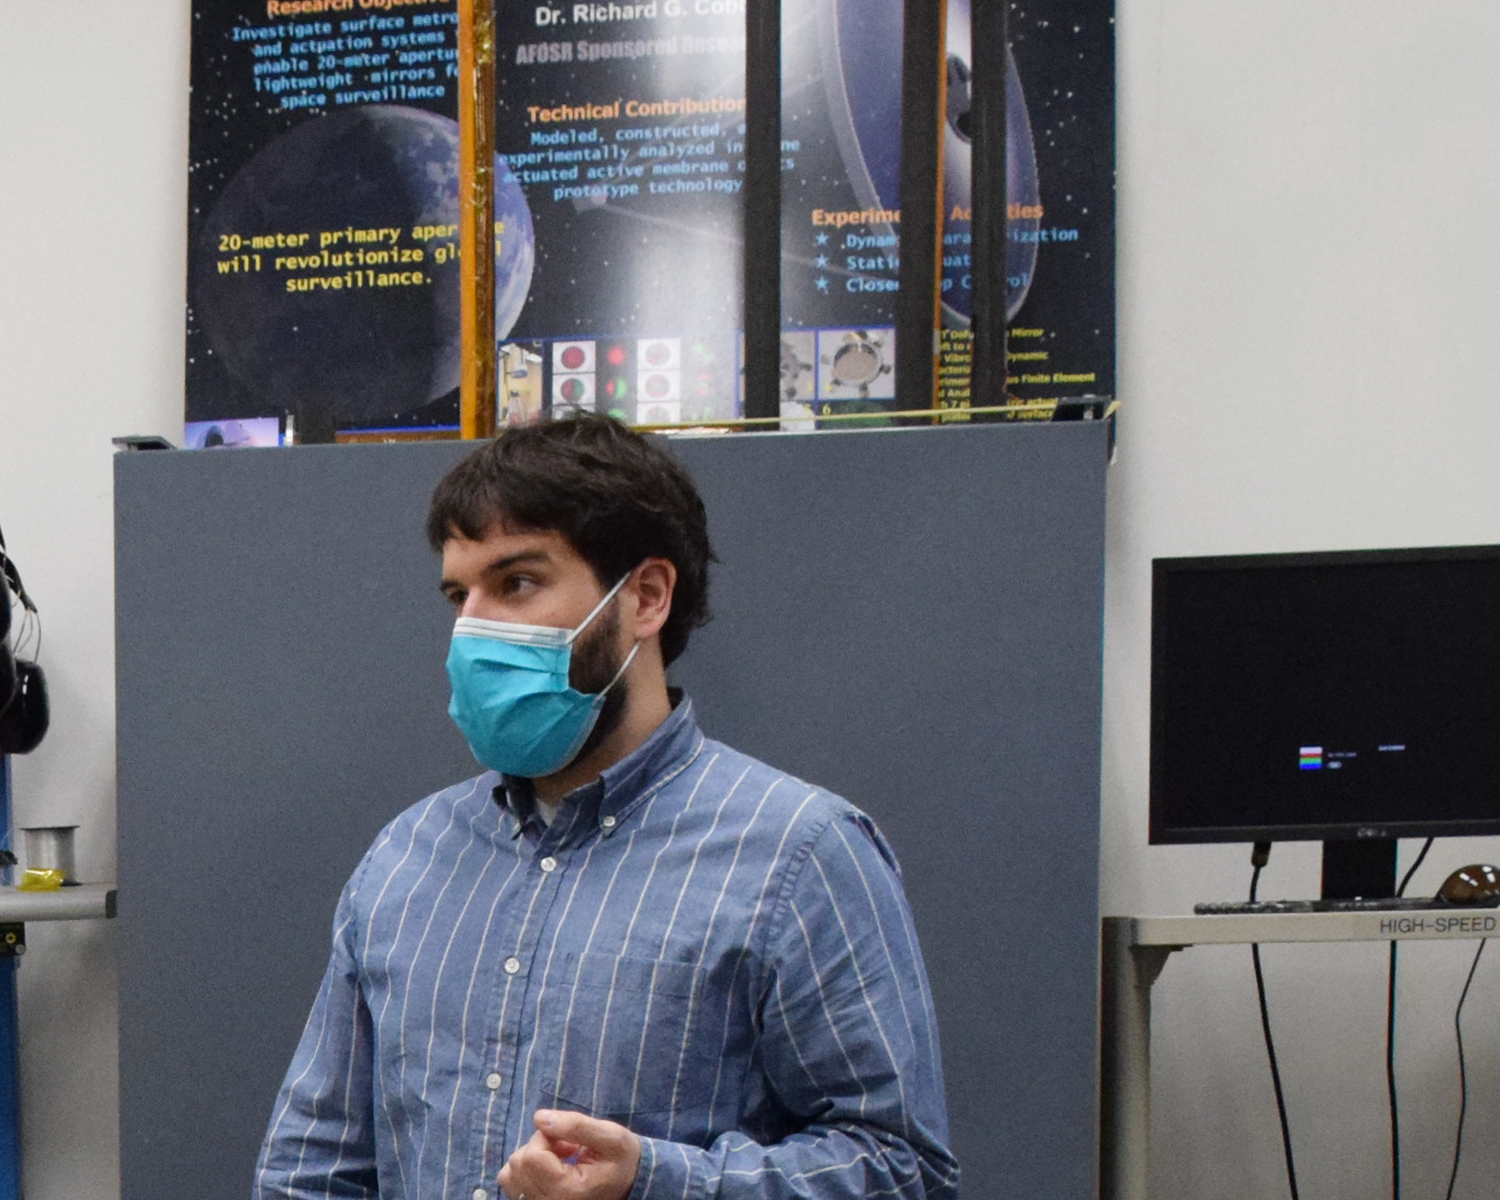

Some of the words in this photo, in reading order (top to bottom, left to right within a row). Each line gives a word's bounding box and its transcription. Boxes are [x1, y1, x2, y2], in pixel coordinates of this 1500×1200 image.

[267, 0, 352, 15] Research
[535, 6, 566, 26] Dr.
[573, 2, 656, 24] Richard
[664, 0, 687, 17] G.
[232, 21, 332, 41] Investigate
[340, 15, 405, 32] surface
[412, 12, 458, 27] metro
[253, 42, 282, 57] and
[290, 36, 373, 54] actuation
[381, 31, 445, 49] systems
[515, 43, 573, 65] AFOSR
[577, 37, 678, 61] Sponsored
[253, 58, 309, 75] enable
[317, 52, 390, 70] 20-meter
[398, 48, 459, 66] apertu
[254, 72, 353, 93] lightweight
[370, 67, 436, 84] mirrors
[280, 93, 327, 110] space
[334, 84, 445, 104] surveillance
[528, 101, 620, 123] Technical
[625, 97, 746, 118] Contribution
[530, 128, 604, 146] Modeled,
[615, 122, 726, 141] constructed,
[500, 141, 630, 167] experimentally
[639, 140, 715, 161] analyzed
[503, 166, 578, 185] actuated
[587, 161, 644, 179] active
[652, 158, 729, 176] membrane
[553, 181, 639, 201] prototype
[649, 176, 742, 194] technology
[219, 232, 309, 252] 20-meter
[320, 227, 401, 248] primary
[217, 254, 261, 274] will
[275, 247, 424, 271] revolutionize
[286, 270, 432, 292] surveillance.
[1053, 372, 1096, 383] Element
[1379, 916, 1497, 934] HIGH-SPEED
